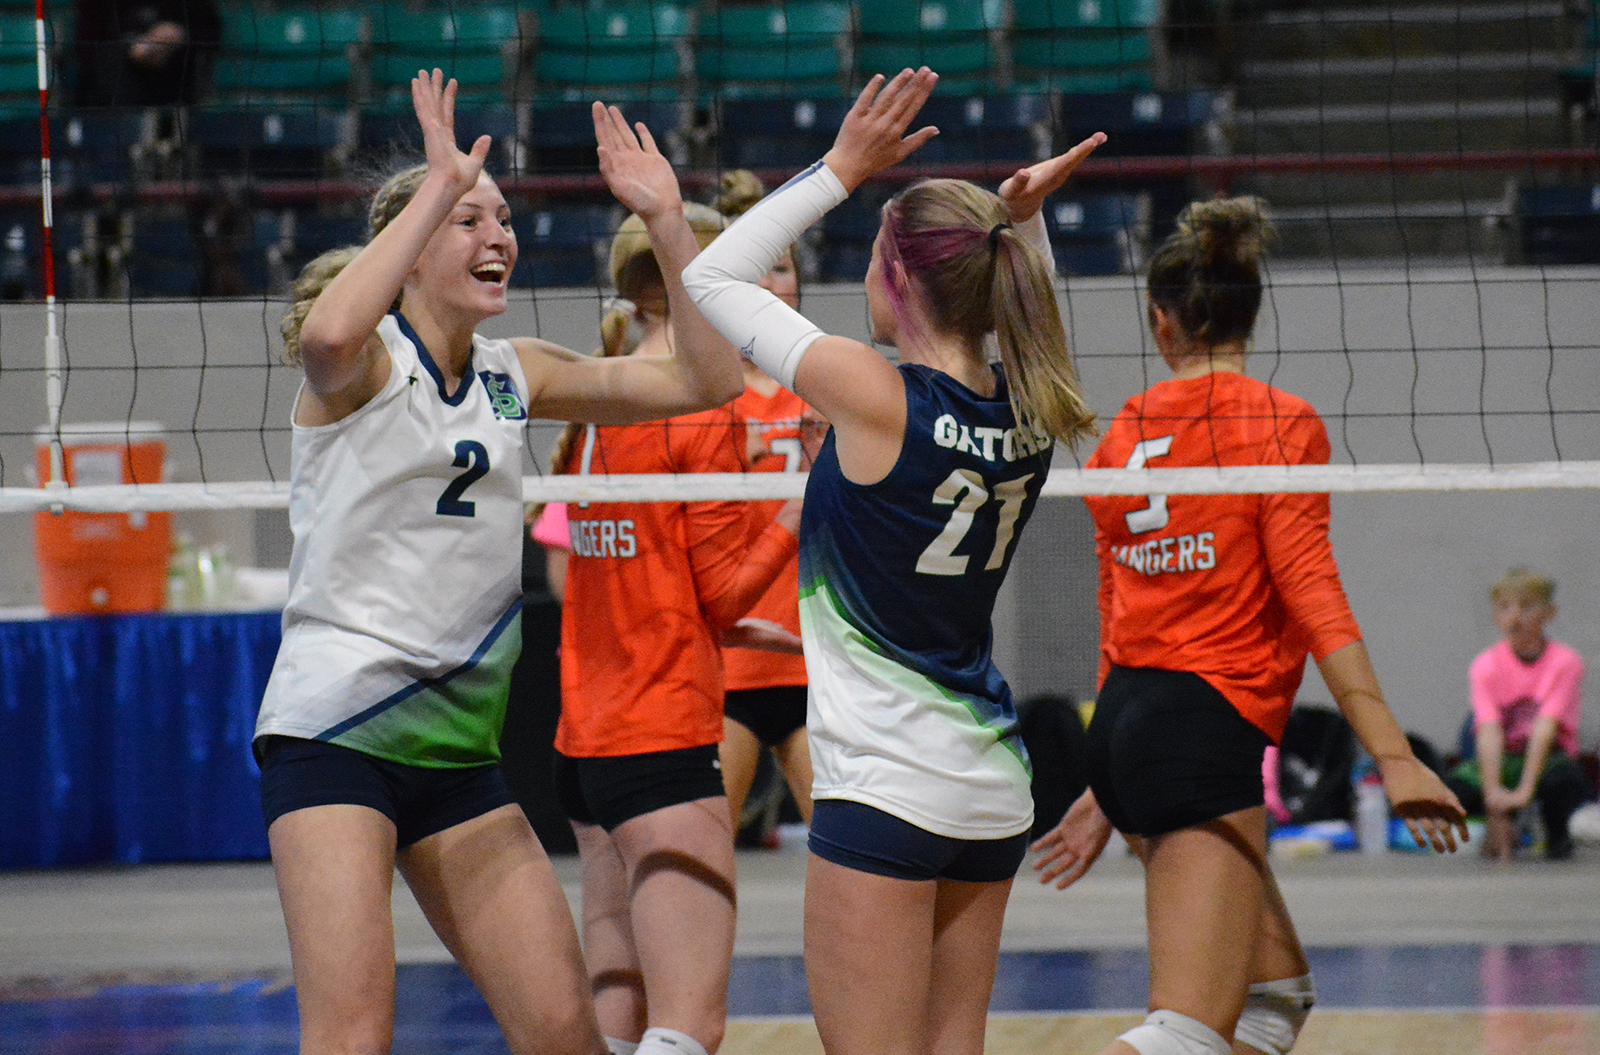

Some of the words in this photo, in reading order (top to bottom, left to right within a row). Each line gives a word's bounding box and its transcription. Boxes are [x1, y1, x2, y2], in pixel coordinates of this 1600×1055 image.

[436, 440, 490, 517] 2
[915, 468, 1035, 576] 21
[1125, 435, 1174, 535] 5
